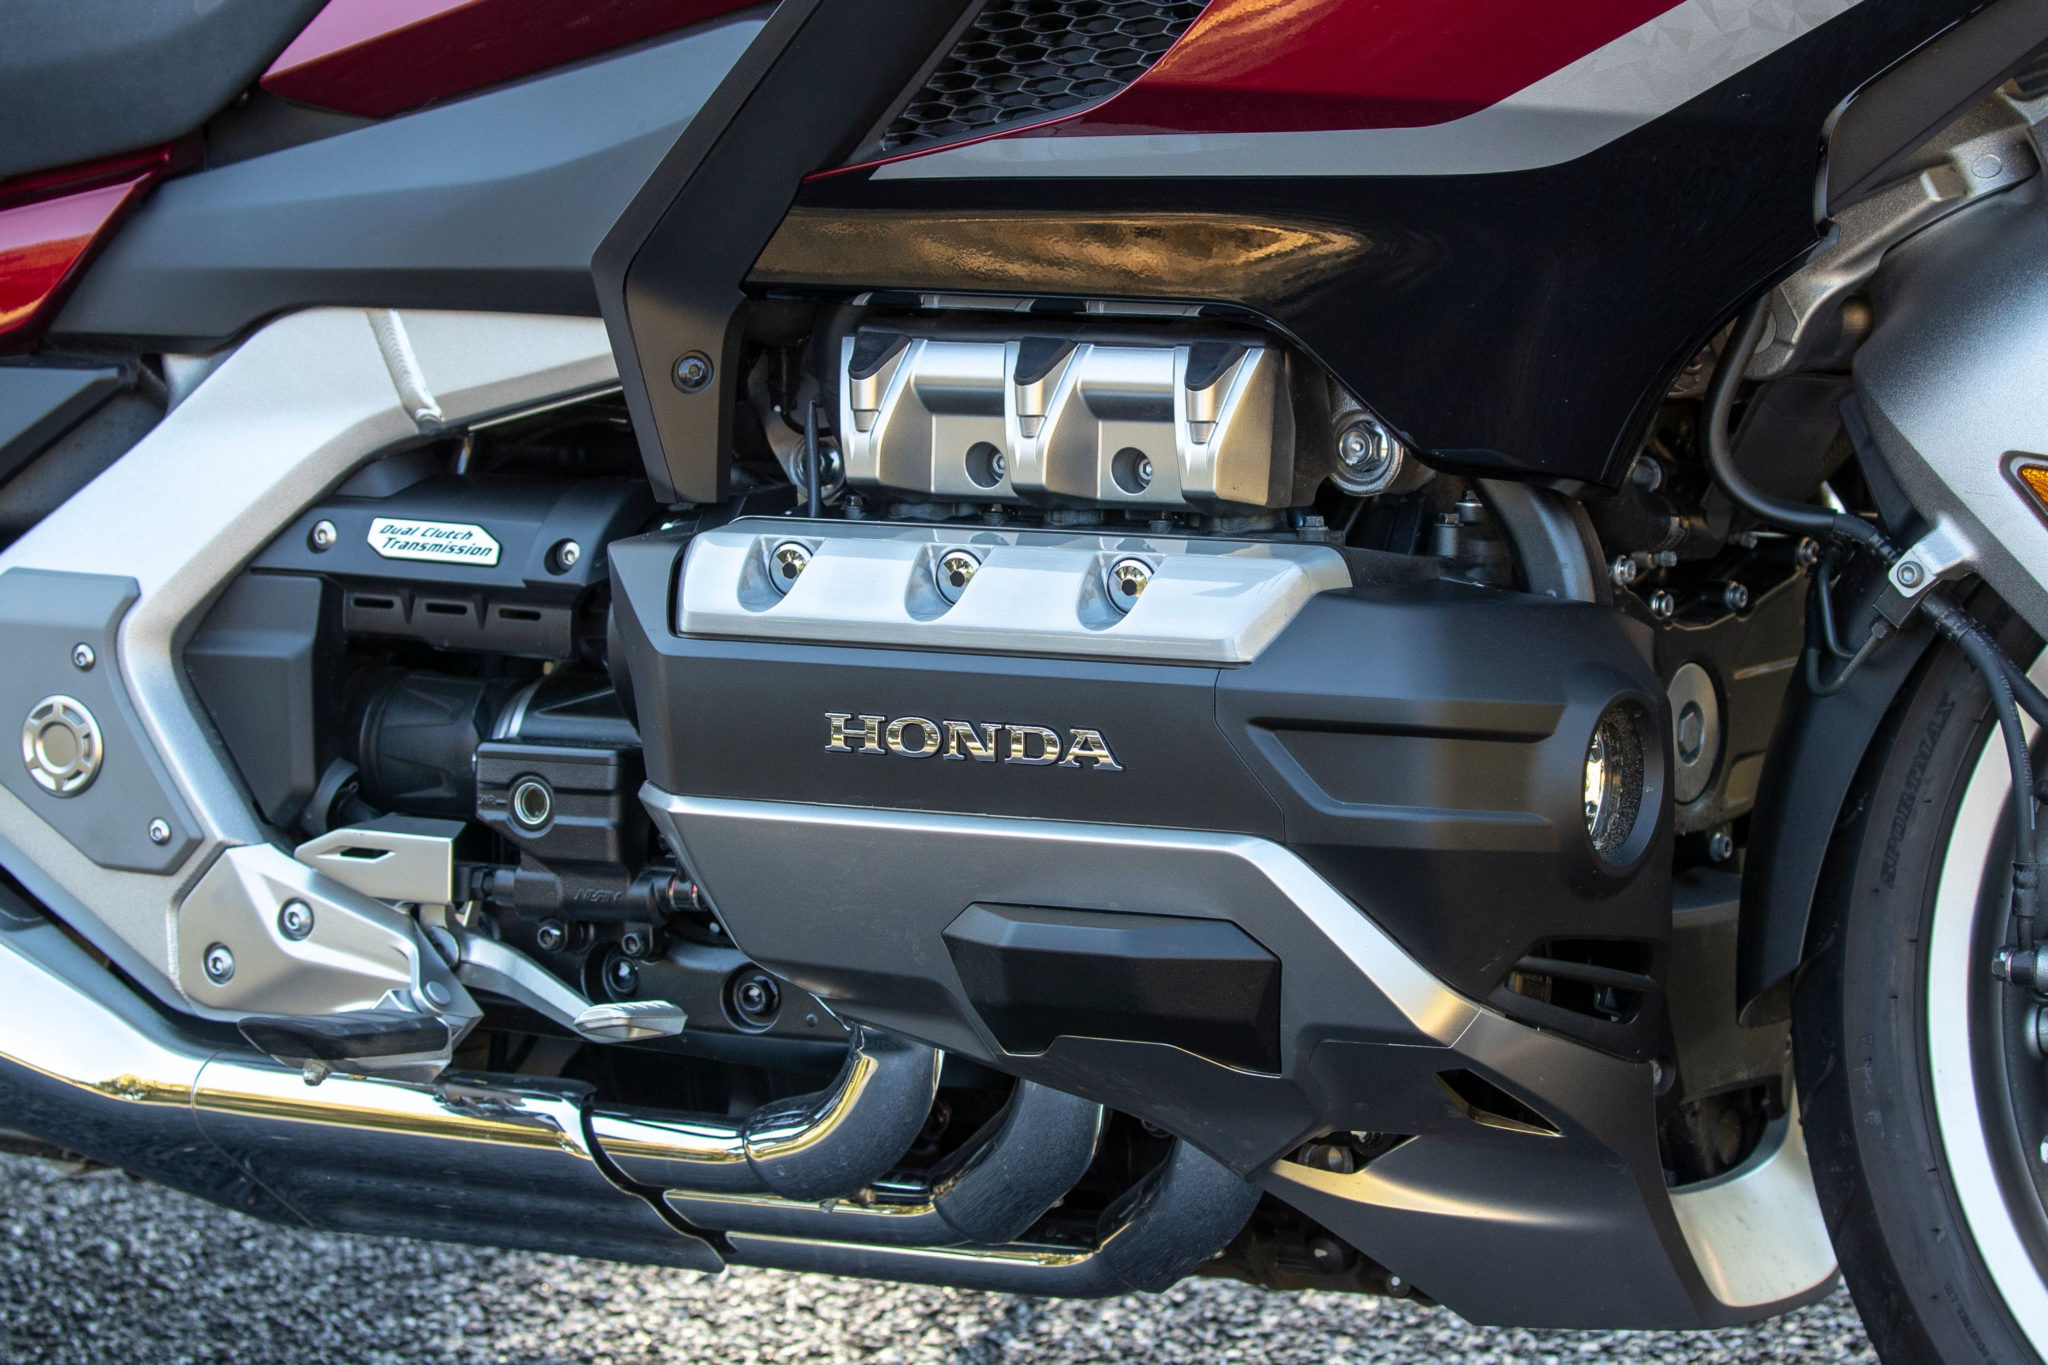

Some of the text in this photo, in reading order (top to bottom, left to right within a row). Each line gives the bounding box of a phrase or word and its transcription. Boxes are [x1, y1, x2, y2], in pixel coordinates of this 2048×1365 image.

[379, 524, 474, 540] Dual Clutch
[382, 537, 493, 557] Transmission
[825, 712, 1126, 772] HONDA
[1880, 691, 1956, 889] SPORTMAX
